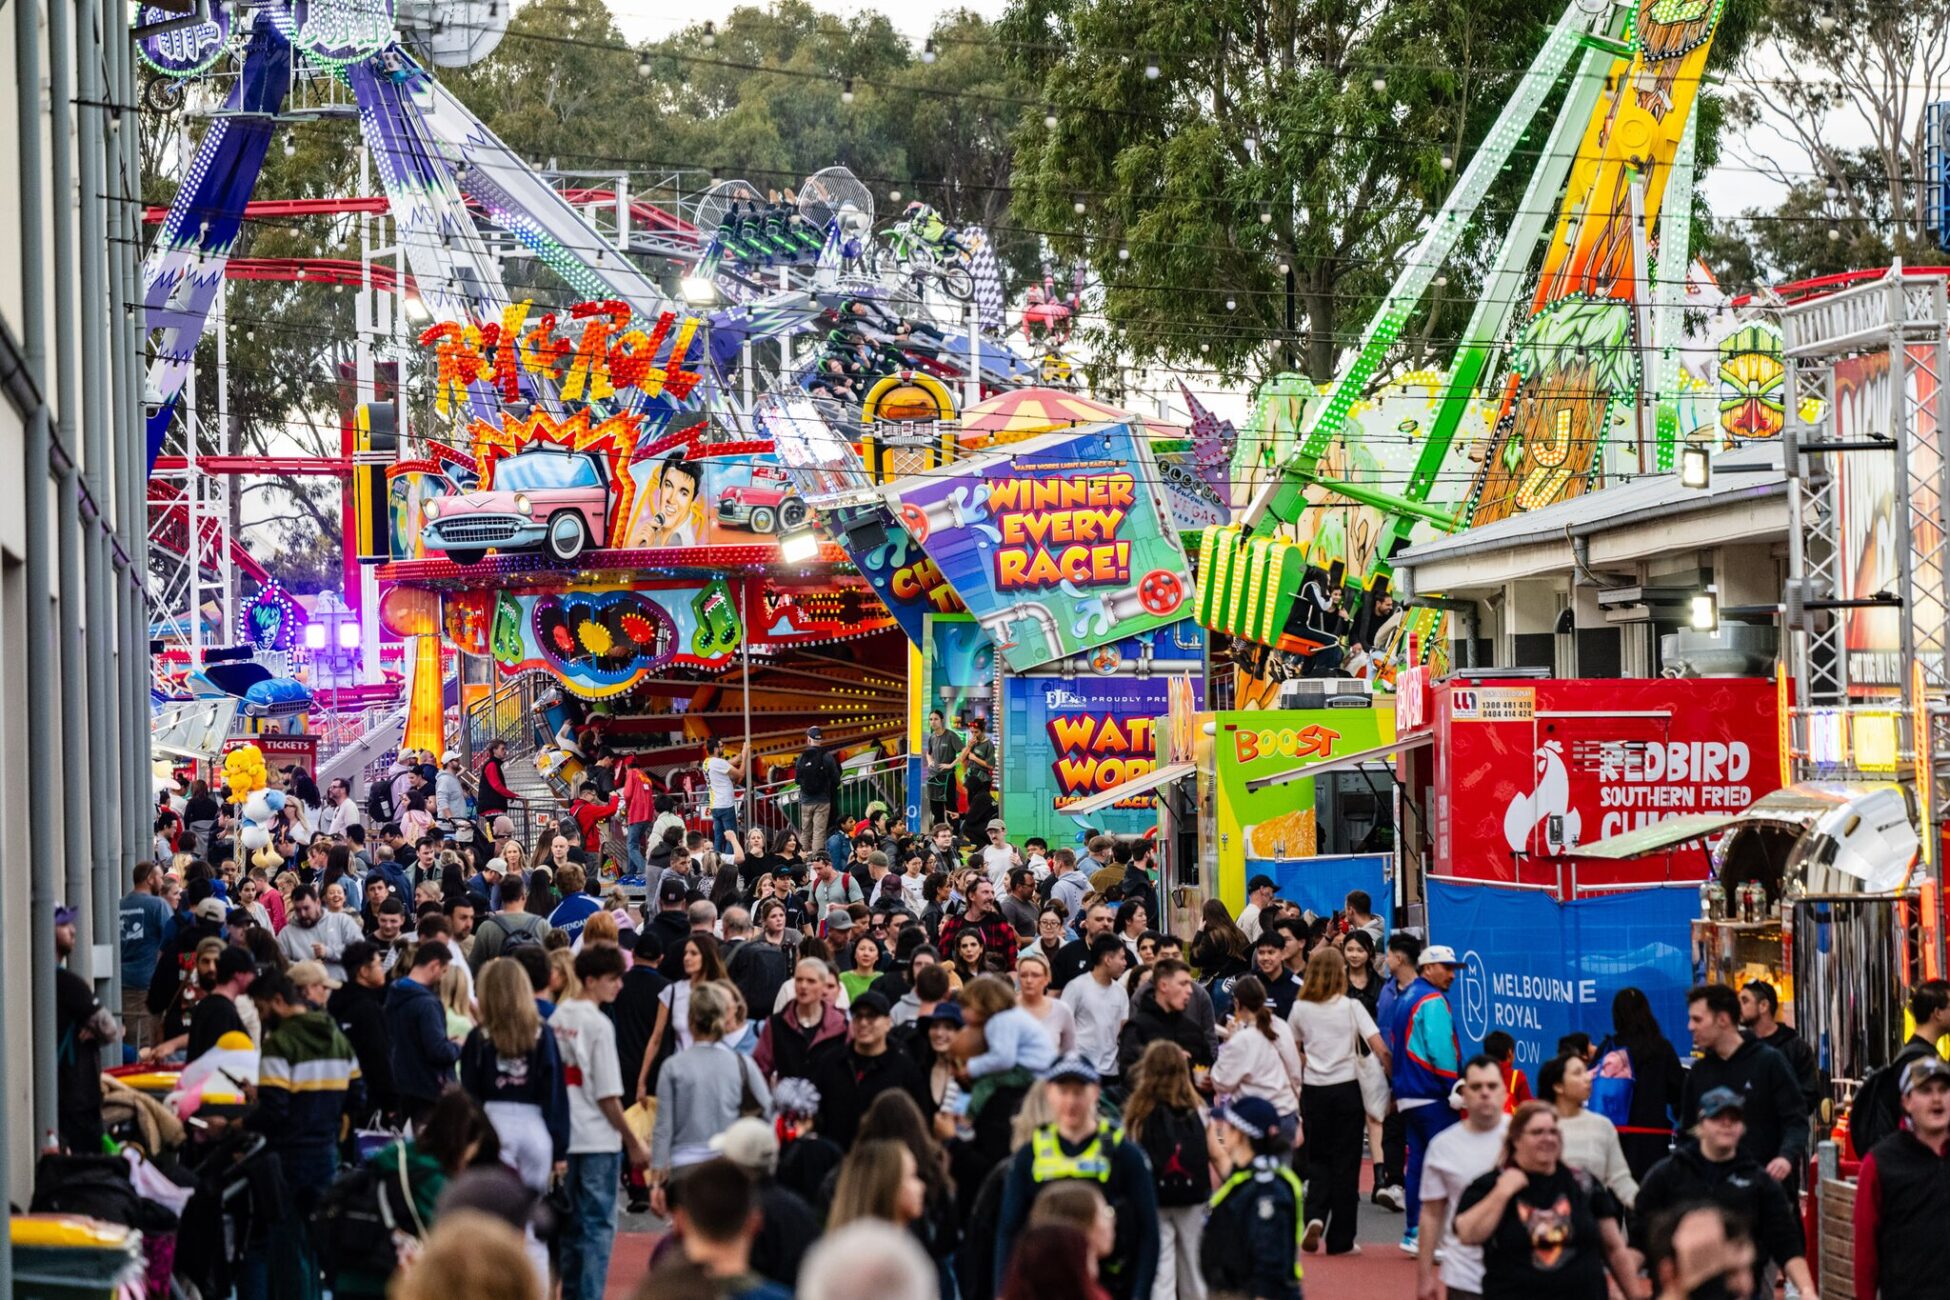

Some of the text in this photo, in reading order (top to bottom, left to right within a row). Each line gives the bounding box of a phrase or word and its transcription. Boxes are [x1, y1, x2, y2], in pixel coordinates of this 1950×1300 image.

[986, 475, 1135, 515] WINNER
[1000, 506, 1126, 548] EVERY
[997, 541, 1131, 589] RACE!
[265, 741, 310, 750] TICKETS
[1051, 715, 1156, 755] WAT
[1234, 724, 1341, 763] BOOST
[1599, 741, 1751, 782] REDBIRD
[1600, 786, 1752, 807] SOUTHERN FRIED
[1492, 972, 1597, 1004] MELBOURNE
[1494, 1004, 1542, 1030] ROYAL
